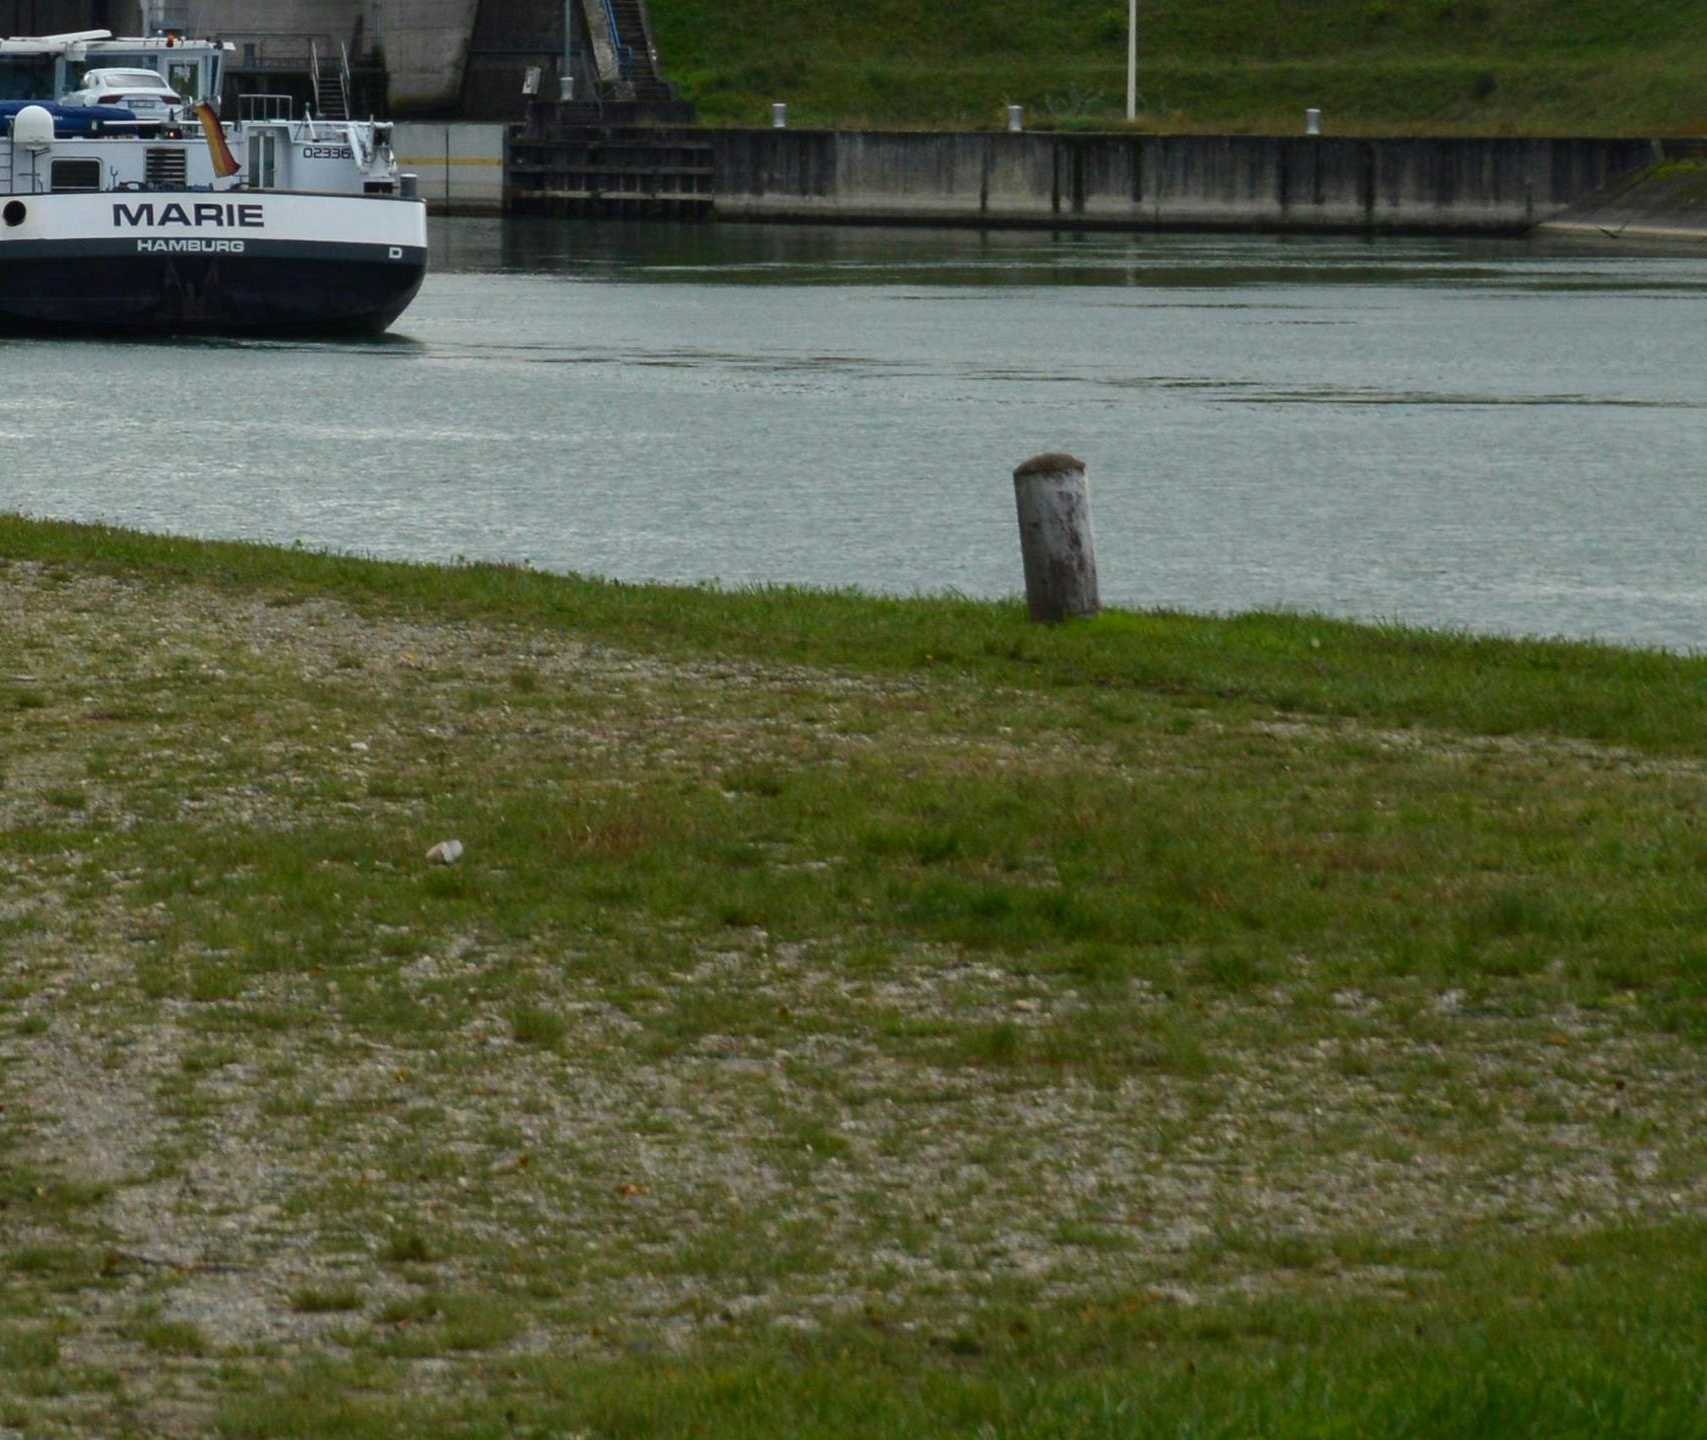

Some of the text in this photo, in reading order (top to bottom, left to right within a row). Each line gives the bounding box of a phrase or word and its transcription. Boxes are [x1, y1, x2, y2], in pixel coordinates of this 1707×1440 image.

[303, 147, 356, 160] 02336
[112, 203, 264, 228] MARIE
[137, 239, 244, 253] HAMBURG
[388, 247, 403, 259] D
